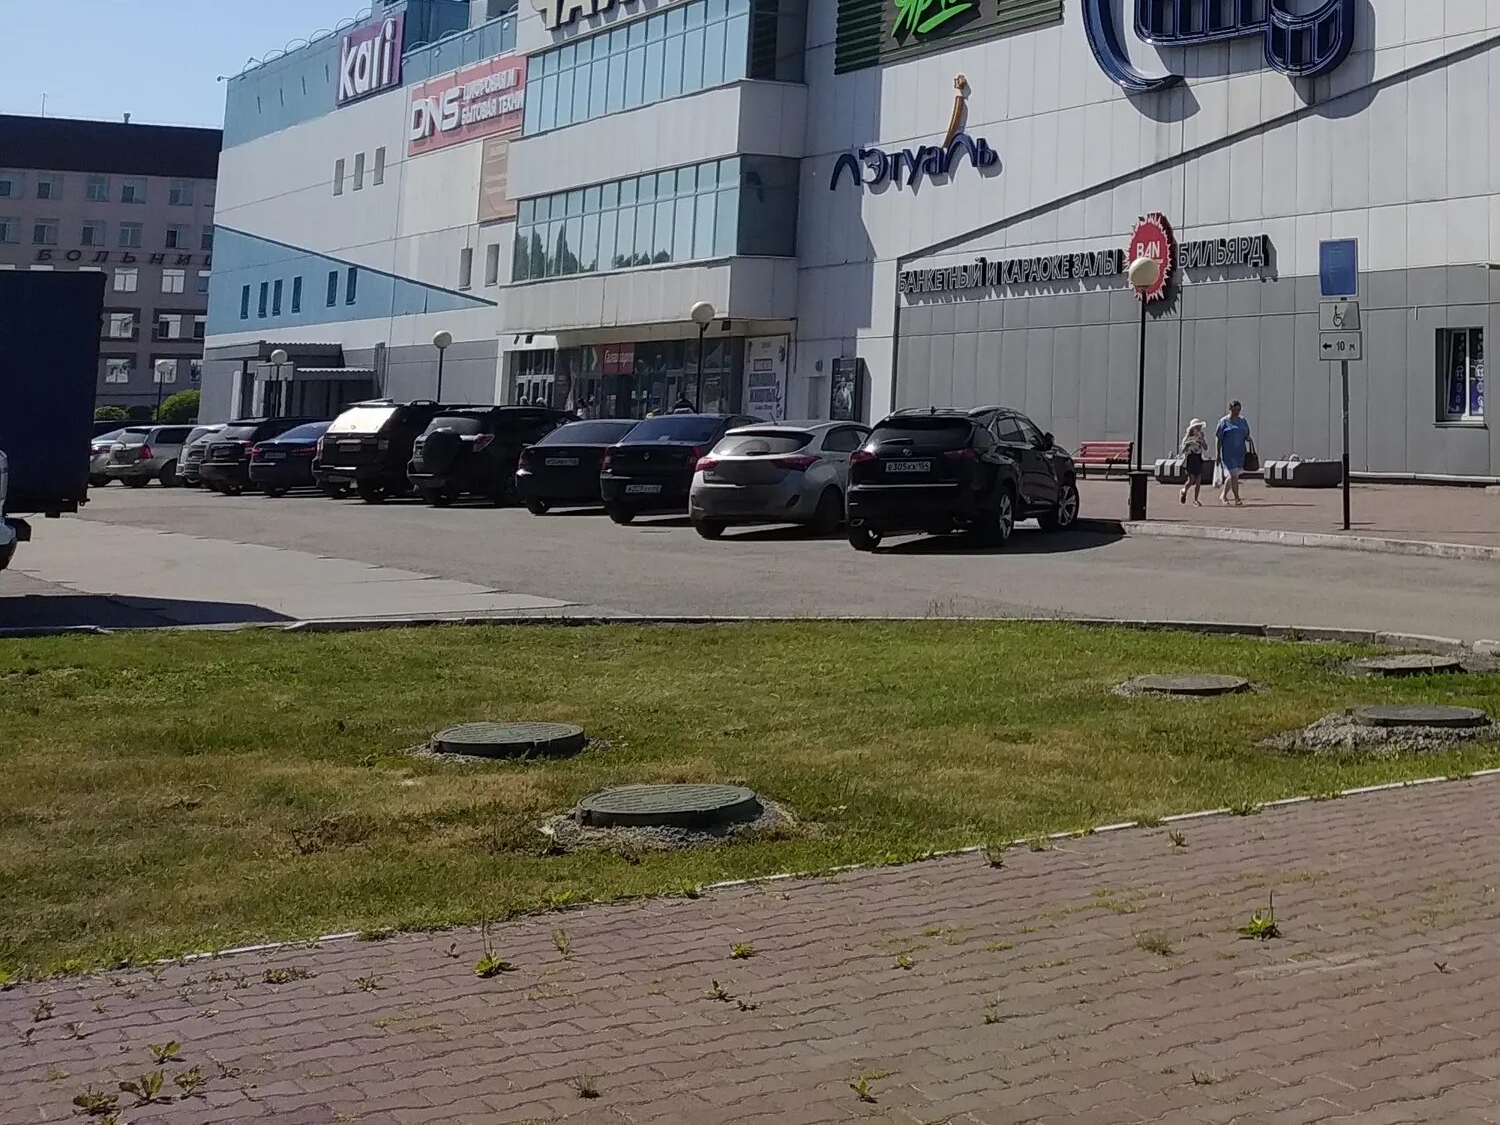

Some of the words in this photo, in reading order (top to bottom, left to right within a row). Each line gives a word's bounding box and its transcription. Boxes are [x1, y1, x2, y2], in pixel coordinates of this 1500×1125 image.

[339, 18, 395, 100] kari
[411, 87, 463, 141] DNS
[899, 257, 983, 293] БАНКЕТНЫЙ
[986, 261, 998, 286] И
[1000, 252, 1070, 285] КАРАОКЕ
[1072, 248, 1118, 277] ЗАЛЫ
[1178, 234, 1266, 269] БИЛЬЯРД
[1336, 341, 1345, 351] 10
